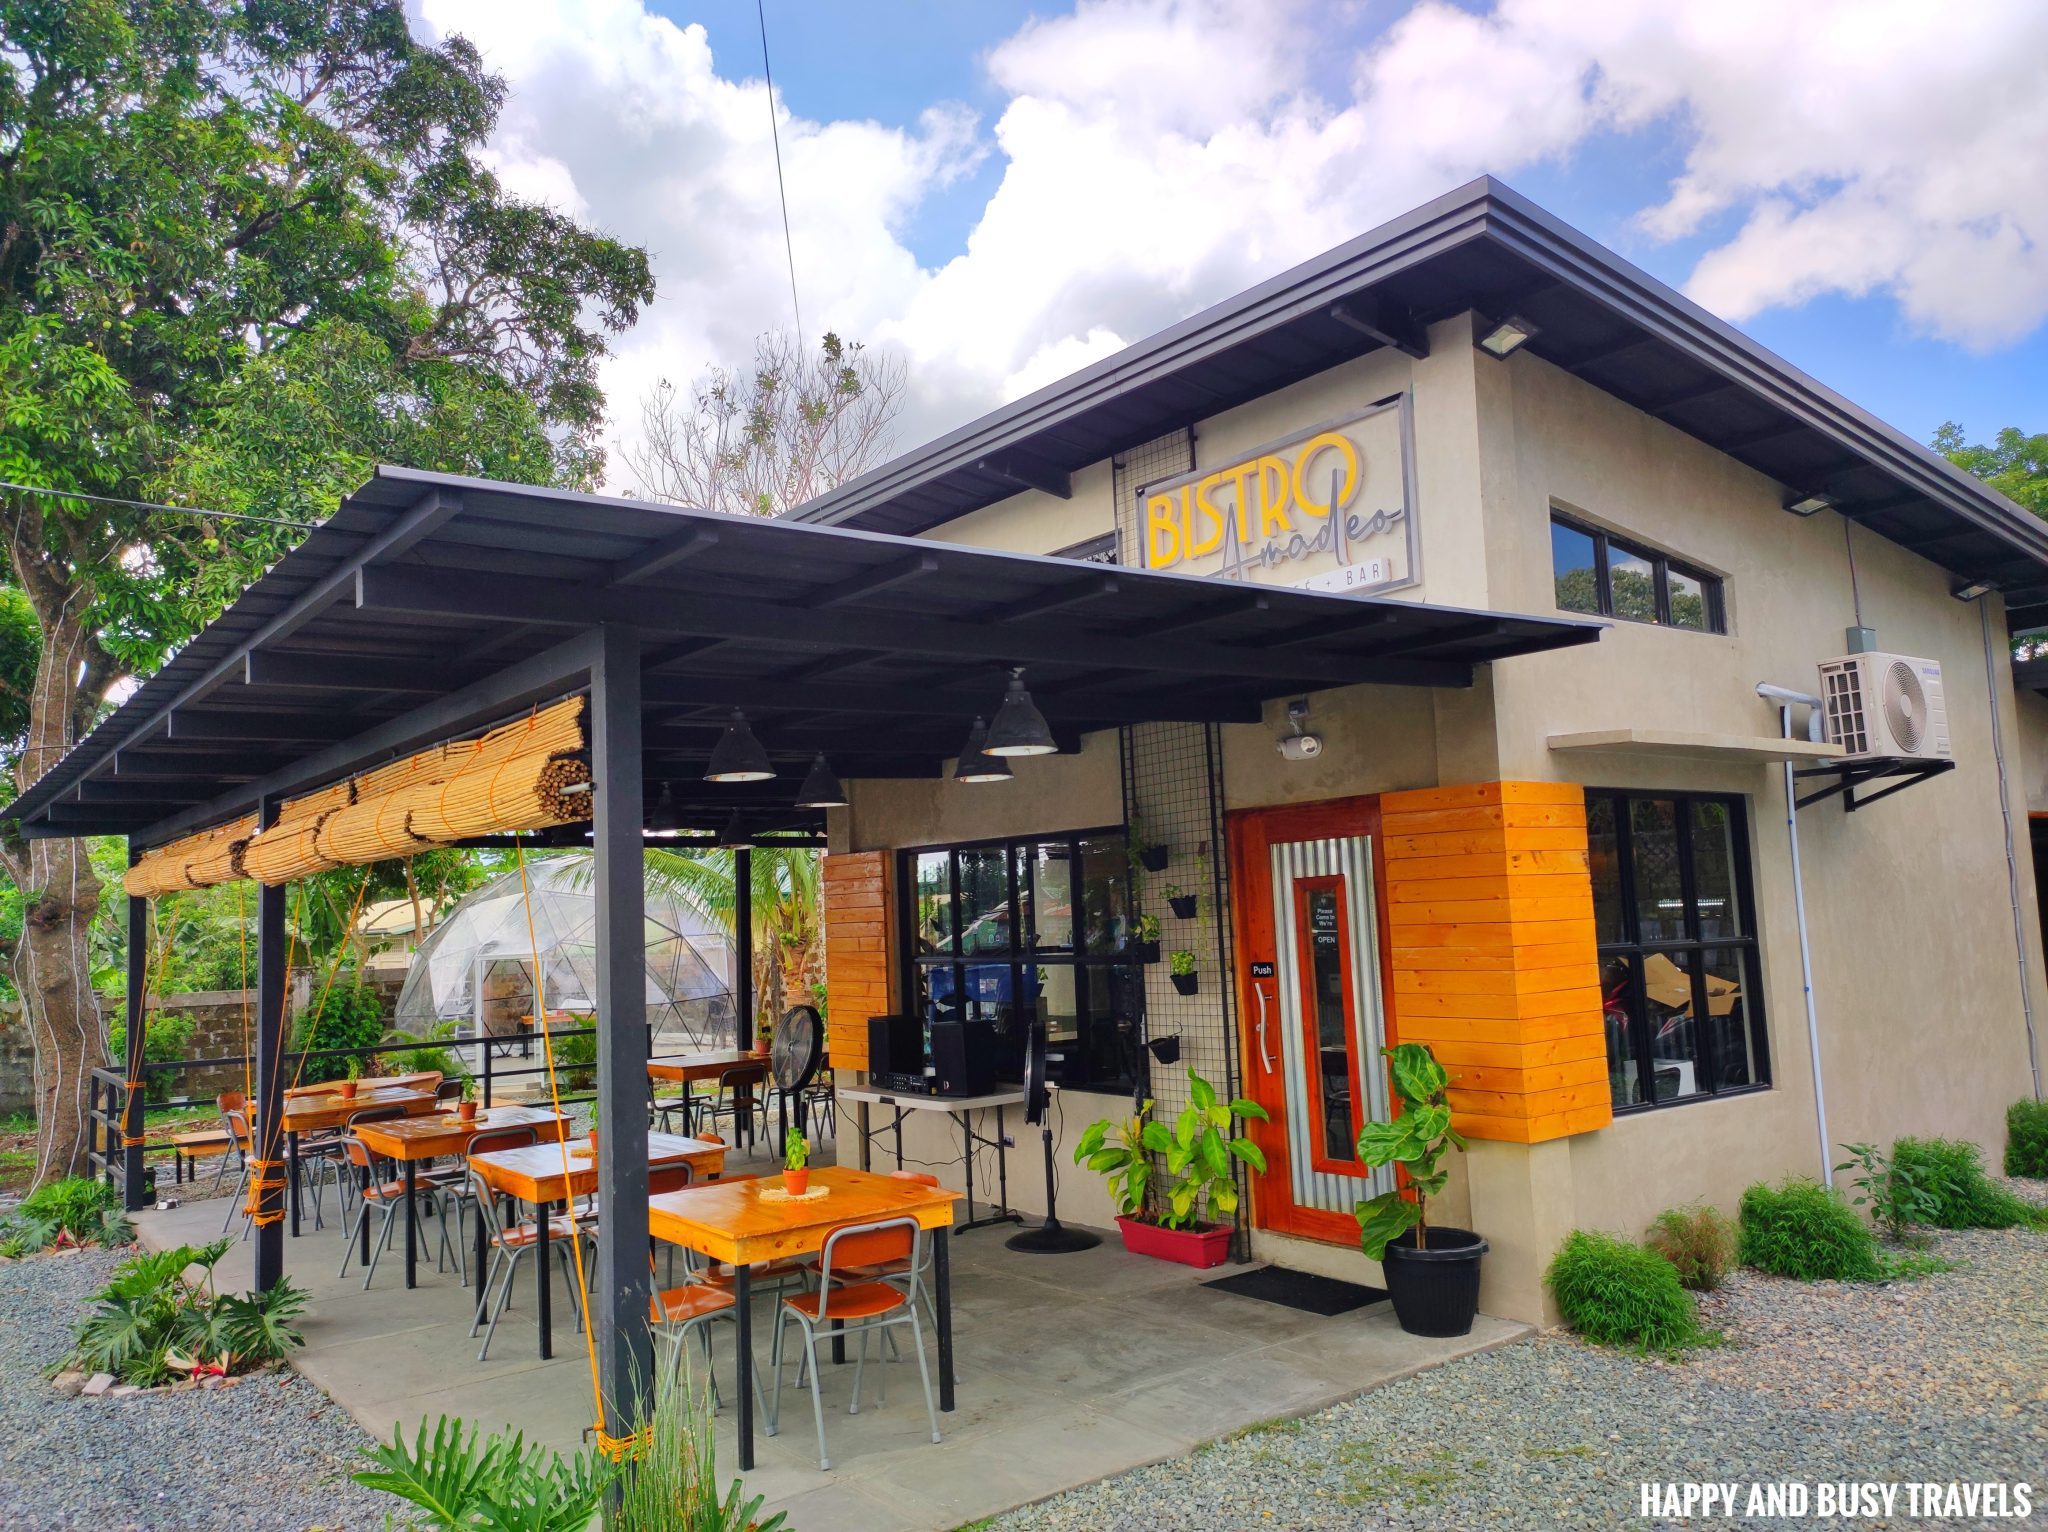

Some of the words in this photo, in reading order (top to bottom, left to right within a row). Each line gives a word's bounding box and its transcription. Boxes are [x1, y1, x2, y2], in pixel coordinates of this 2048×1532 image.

[1147, 432, 1359, 570] BISTRO
[1206, 467, 1402, 582] Amadeo
[1346, 562, 1380, 586] BAR
[1253, 966, 1272, 975] Push
